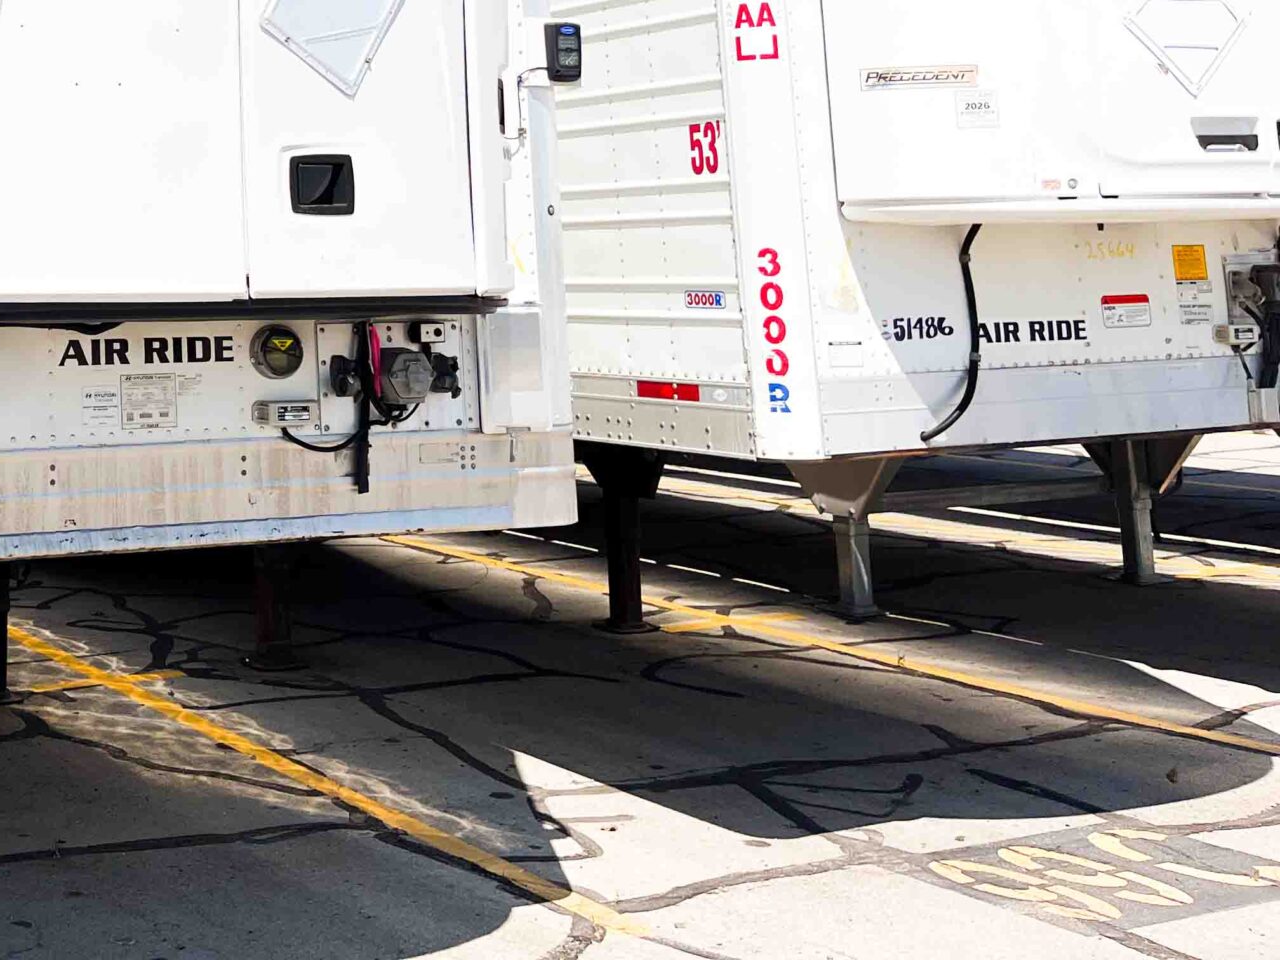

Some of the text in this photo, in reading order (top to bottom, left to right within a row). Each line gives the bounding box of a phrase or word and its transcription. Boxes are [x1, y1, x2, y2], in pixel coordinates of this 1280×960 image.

[964, 101, 991, 111] 2026
[893, 316, 954, 341] 51486
[977, 320, 1087, 343] AIR RIDE
[58, 336, 234, 366] AIR RIDE
